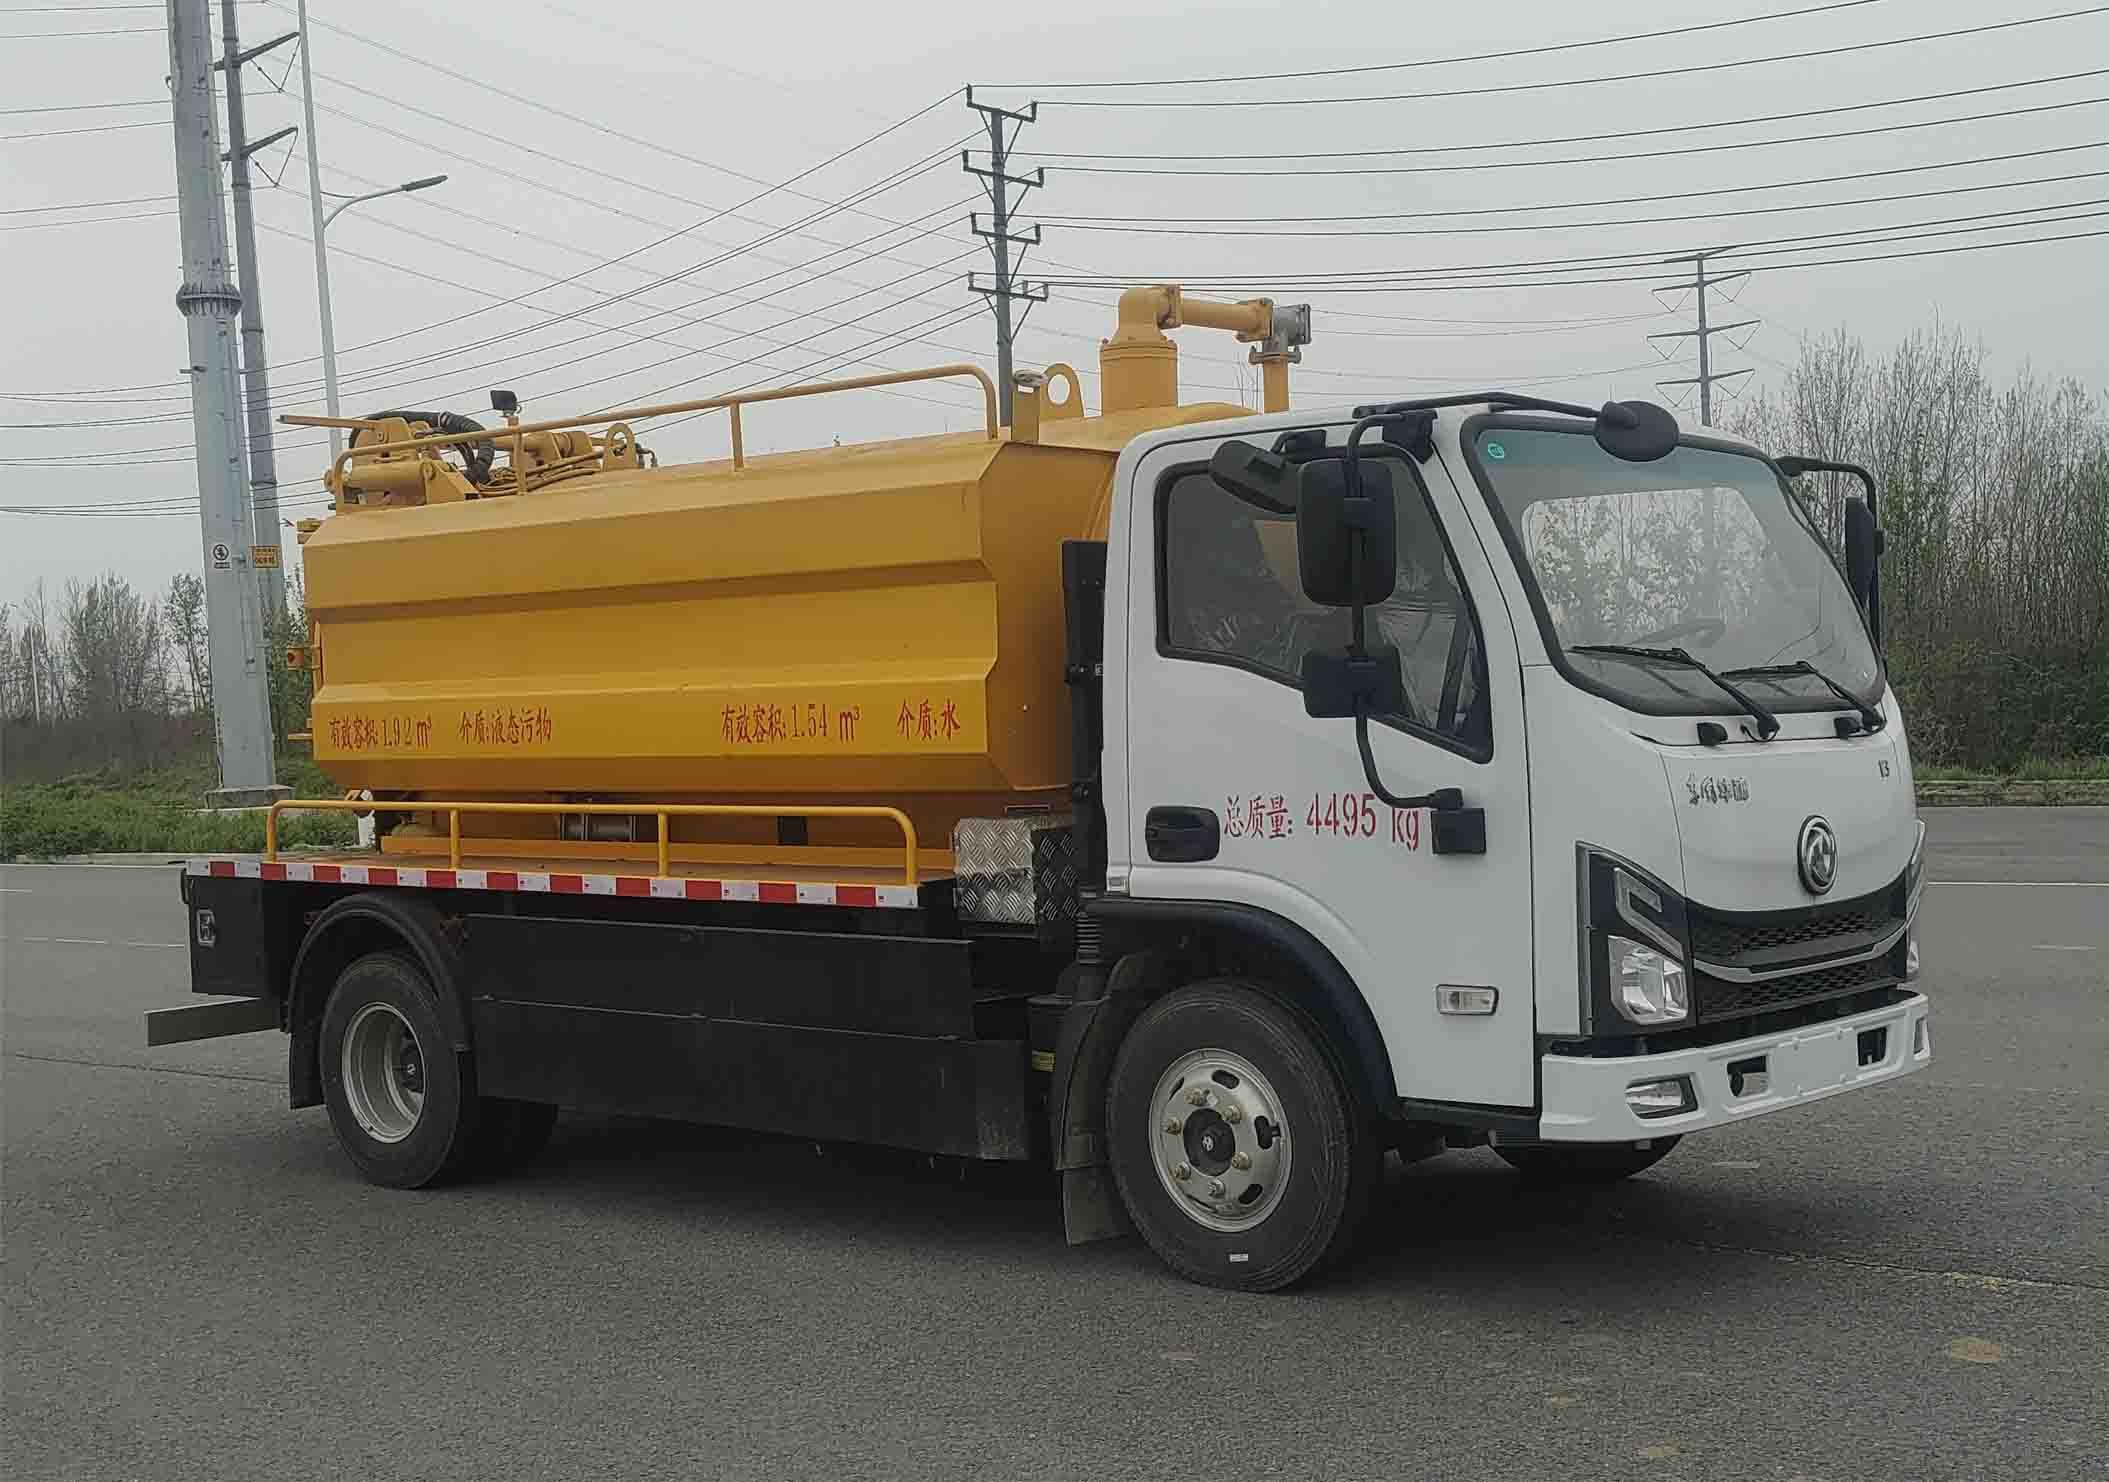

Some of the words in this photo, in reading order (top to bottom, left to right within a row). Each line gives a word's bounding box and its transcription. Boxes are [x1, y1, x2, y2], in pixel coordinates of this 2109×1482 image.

[896, 697, 961, 742] 介质:水
[1306, 793, 1378, 838] 4495
[1391, 806, 1420, 851] kg
